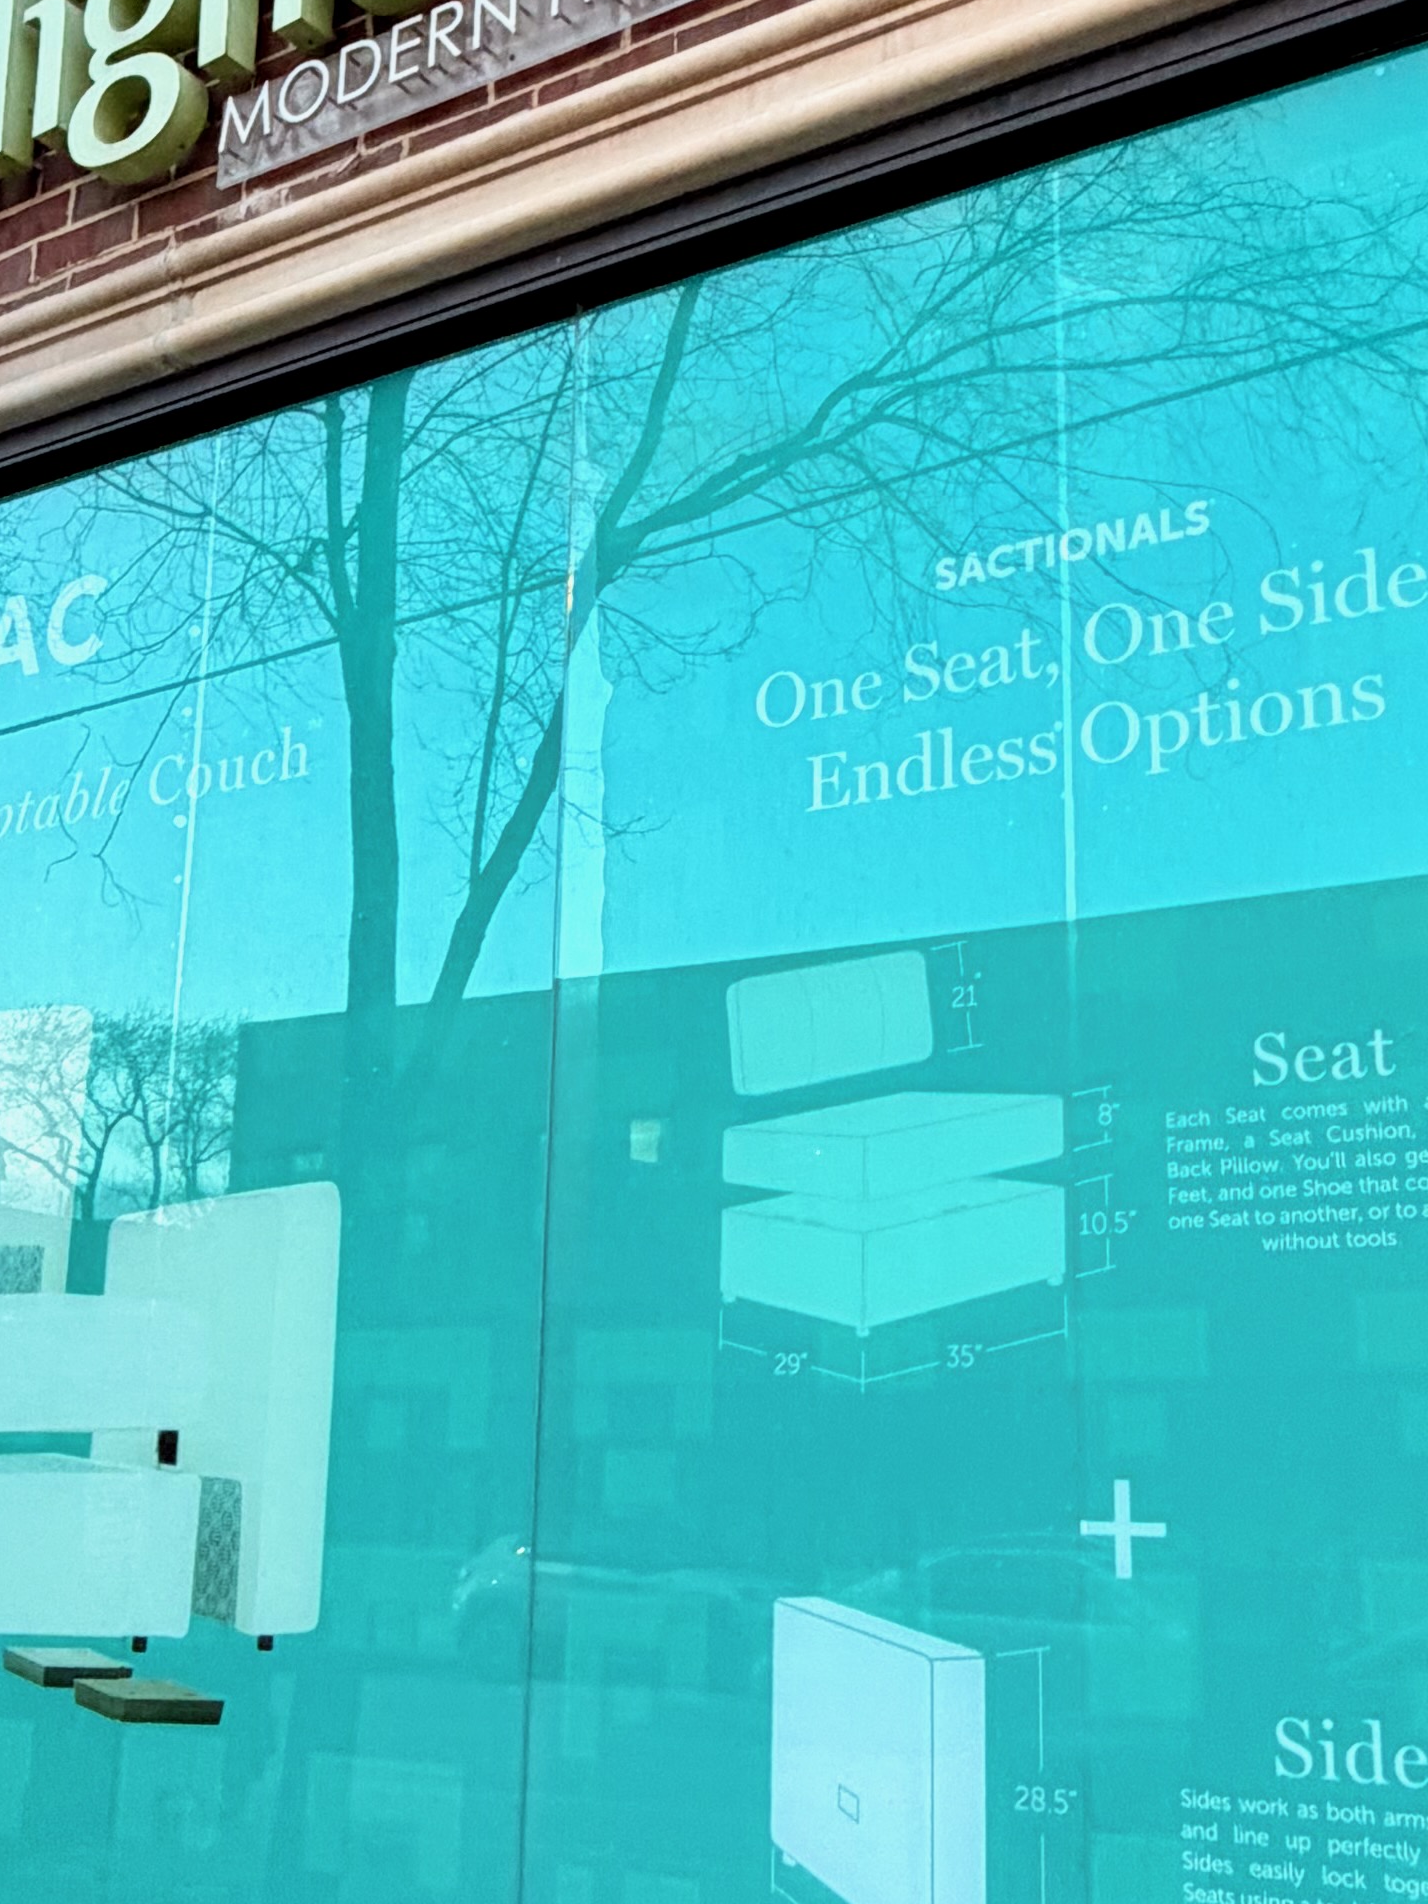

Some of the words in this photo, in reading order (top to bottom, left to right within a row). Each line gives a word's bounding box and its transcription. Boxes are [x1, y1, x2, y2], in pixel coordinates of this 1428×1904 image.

[933, 500, 1211, 592] SACTIONALS
[754, 670, 884, 729] One
[903, 627, 1060, 704] Seat,
[1083, 597, 1236, 666] One
[804, 726, 1058, 813] Endless
[1080, 672, 1386, 776] Options
[148, 726, 310, 807] Couch
[1252, 1028, 1397, 1088] Seat
[1166, 1111, 1211, 1128] Each
[1226, 1106, 1266, 1124] Seat
[1281, 1103, 1347, 1120] comes
[1363, 1095, 1408, 1115] with
[1167, 1136, 1230, 1154] Frame,
[1244, 1135, 1255, 1149] a
[1269, 1129, 1311, 1146] Seat
[1327, 1122, 1416, 1143] Cushion,
[1167, 1160, 1212, 1179] Back
[1293, 1151, 1346, 1170] You'll
[1355, 1149, 1396, 1167] also
[1168, 1187, 1213, 1205] Feet,
[1218, 1182, 1254, 1201] and
[1259, 1184, 1297, 1199] one
[1303, 1179, 1353, 1197] Shoe
[1359, 1176, 1399, 1195] that
[1168, 1215, 1204, 1230] one
[1209, 1209, 1249, 1227] Seat
[1255, 1210, 1275, 1225] to
[1280, 1202, 1363, 1225] another,
[1368, 1205, 1390, 1220] or
[1396, 1202, 1417, 1219] to
[1262, 1232, 1339, 1251] without
[1180, 1788, 1231, 1812] Sides
[1238, 1798, 1289, 1817] work
[1297, 1802, 1318, 1820] as
[1327, 1801, 1375, 1825] both
[1180, 1822, 1218, 1842] and
[1233, 1824, 1269, 1847] line
[1286, 1835, 1311, 1855] up
[1327, 1836, 1421, 1867] perfectly
[1182, 1851, 1234, 1876] Sides
[1249, 1861, 1305, 1888] easily
[1323, 1865, 1367, 1890] lock
